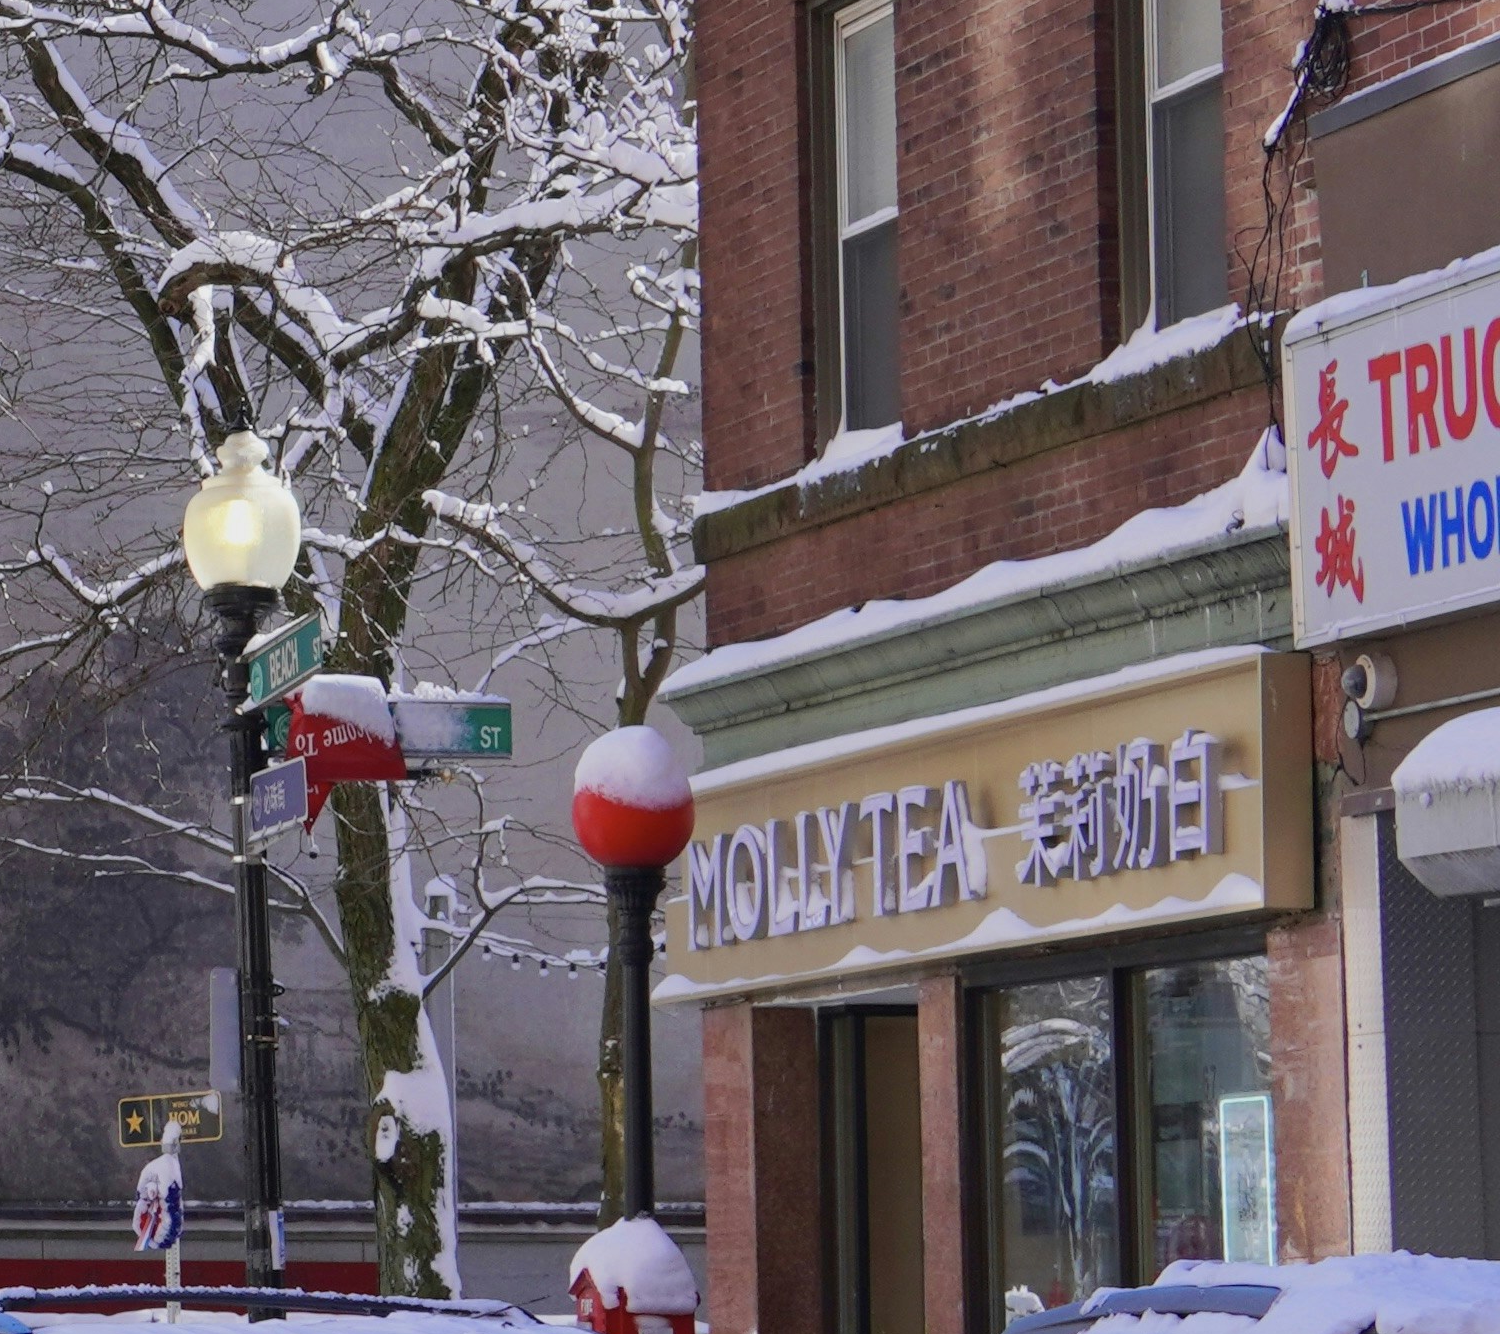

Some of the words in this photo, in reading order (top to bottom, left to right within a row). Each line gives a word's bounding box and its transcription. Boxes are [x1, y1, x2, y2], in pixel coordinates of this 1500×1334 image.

[1308, 358, 1365, 604] 長城
[268, 636, 299, 690] BEACH
[312, 635, 322, 662] ST
[322, 720, 373, 749] lcome
[480, 726, 501, 749] ST
[1016, 729, 1225, 888] 茉莉奶白
[687, 801, 861, 953] MOLLY
[859, 780, 989, 917] TEA
[168, 1109, 200, 1126] HOM
